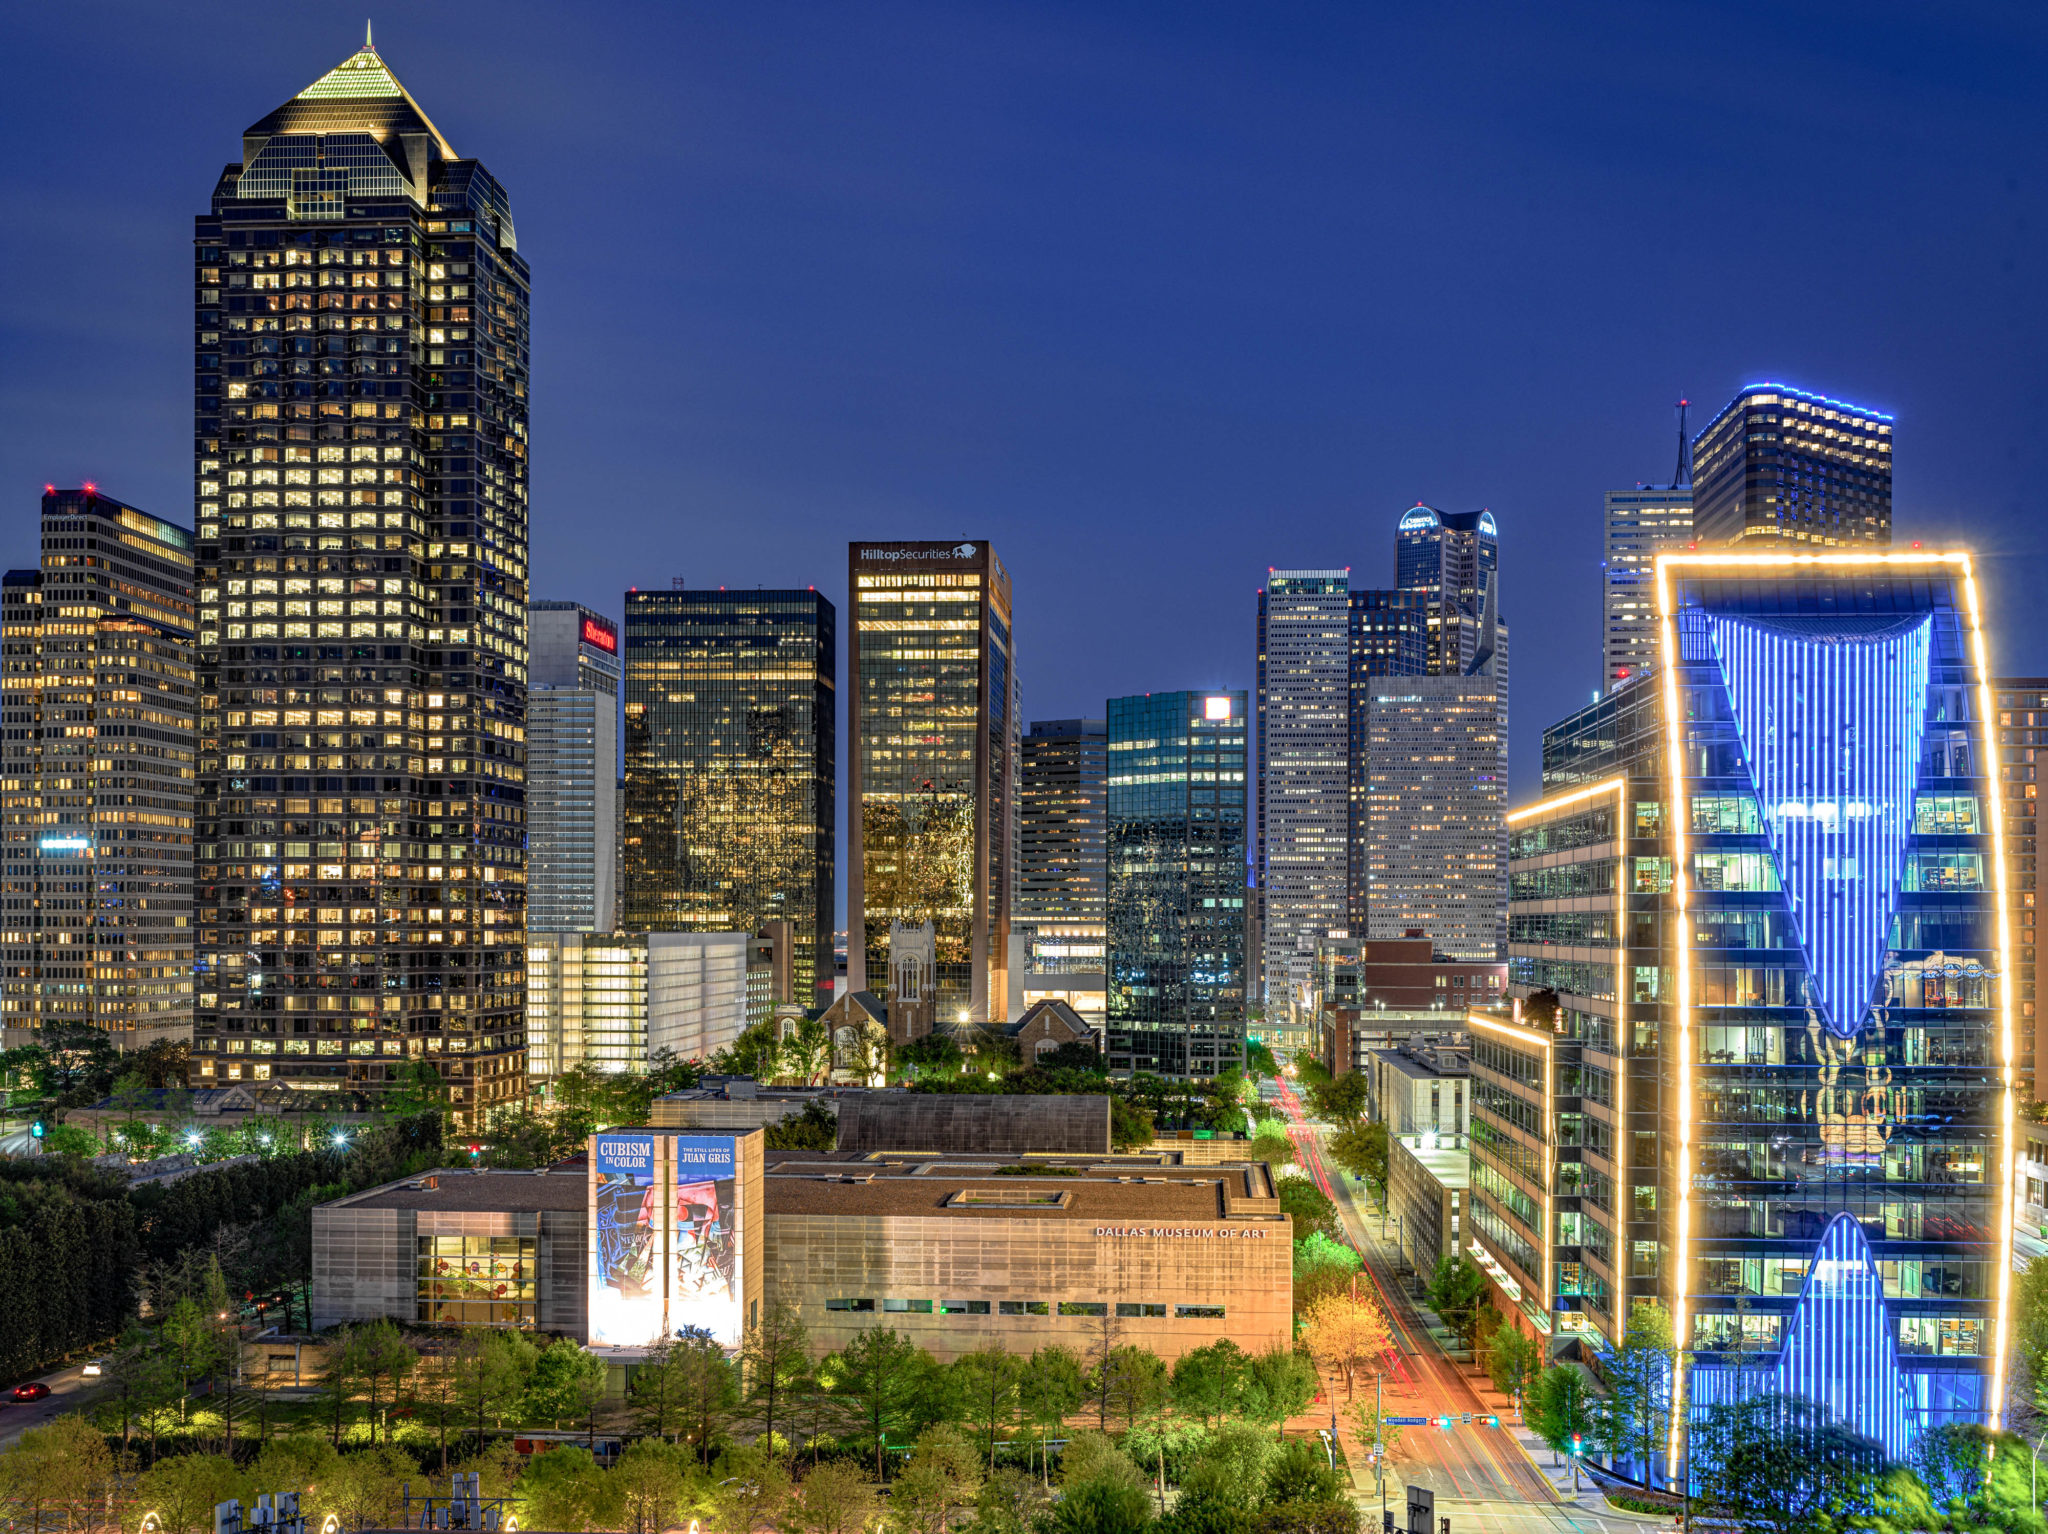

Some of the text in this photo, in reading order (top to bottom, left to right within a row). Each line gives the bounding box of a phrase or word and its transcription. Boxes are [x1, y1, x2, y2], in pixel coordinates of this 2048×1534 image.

[860, 549, 950, 562] HilltopSecurities
[586, 620, 614, 650] Sheraton
[600, 1142, 651, 1157] CUBISM
[605, 1156, 646, 1168] IN COLOR
[682, 1153, 731, 1164] JUAN GRIS
[1096, 1227, 1269, 1239] DALLAS MUSEUM OF ART
